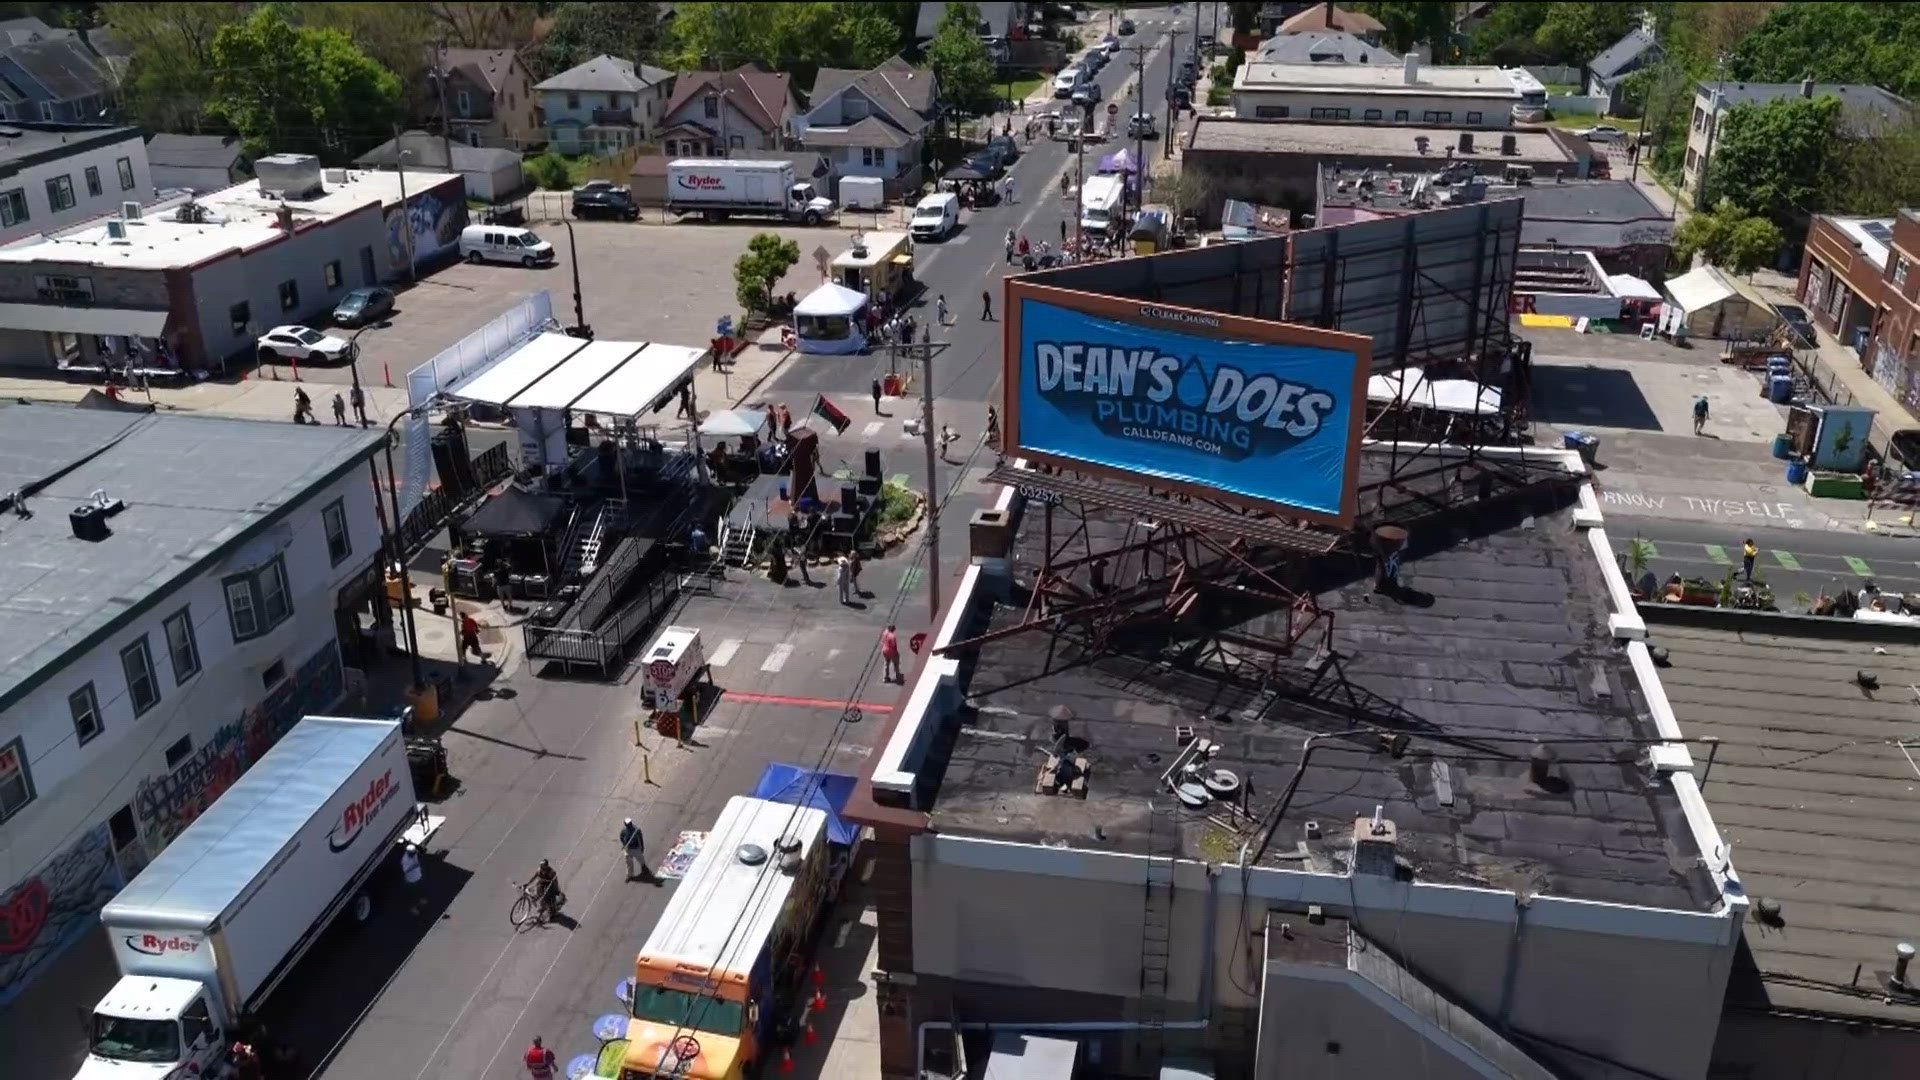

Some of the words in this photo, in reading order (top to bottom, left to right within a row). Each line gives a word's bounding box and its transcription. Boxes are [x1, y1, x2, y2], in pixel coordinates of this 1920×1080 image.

[688, 174, 721, 186] Ryder
[1037, 343, 1180, 403] DEAN'S
[1205, 367, 1332, 438] DOES
[1096, 399, 1251, 450] PLUMBING
[1122, 426, 1222, 456] CALLDEANS.COM
[1603, 491, 1664, 509] KNOW
[1680, 496, 1795, 519] THYSELF
[651, 667, 672, 676] STOP
[343, 767, 392, 834] Ryder
[142, 934, 199, 953] Ryder
